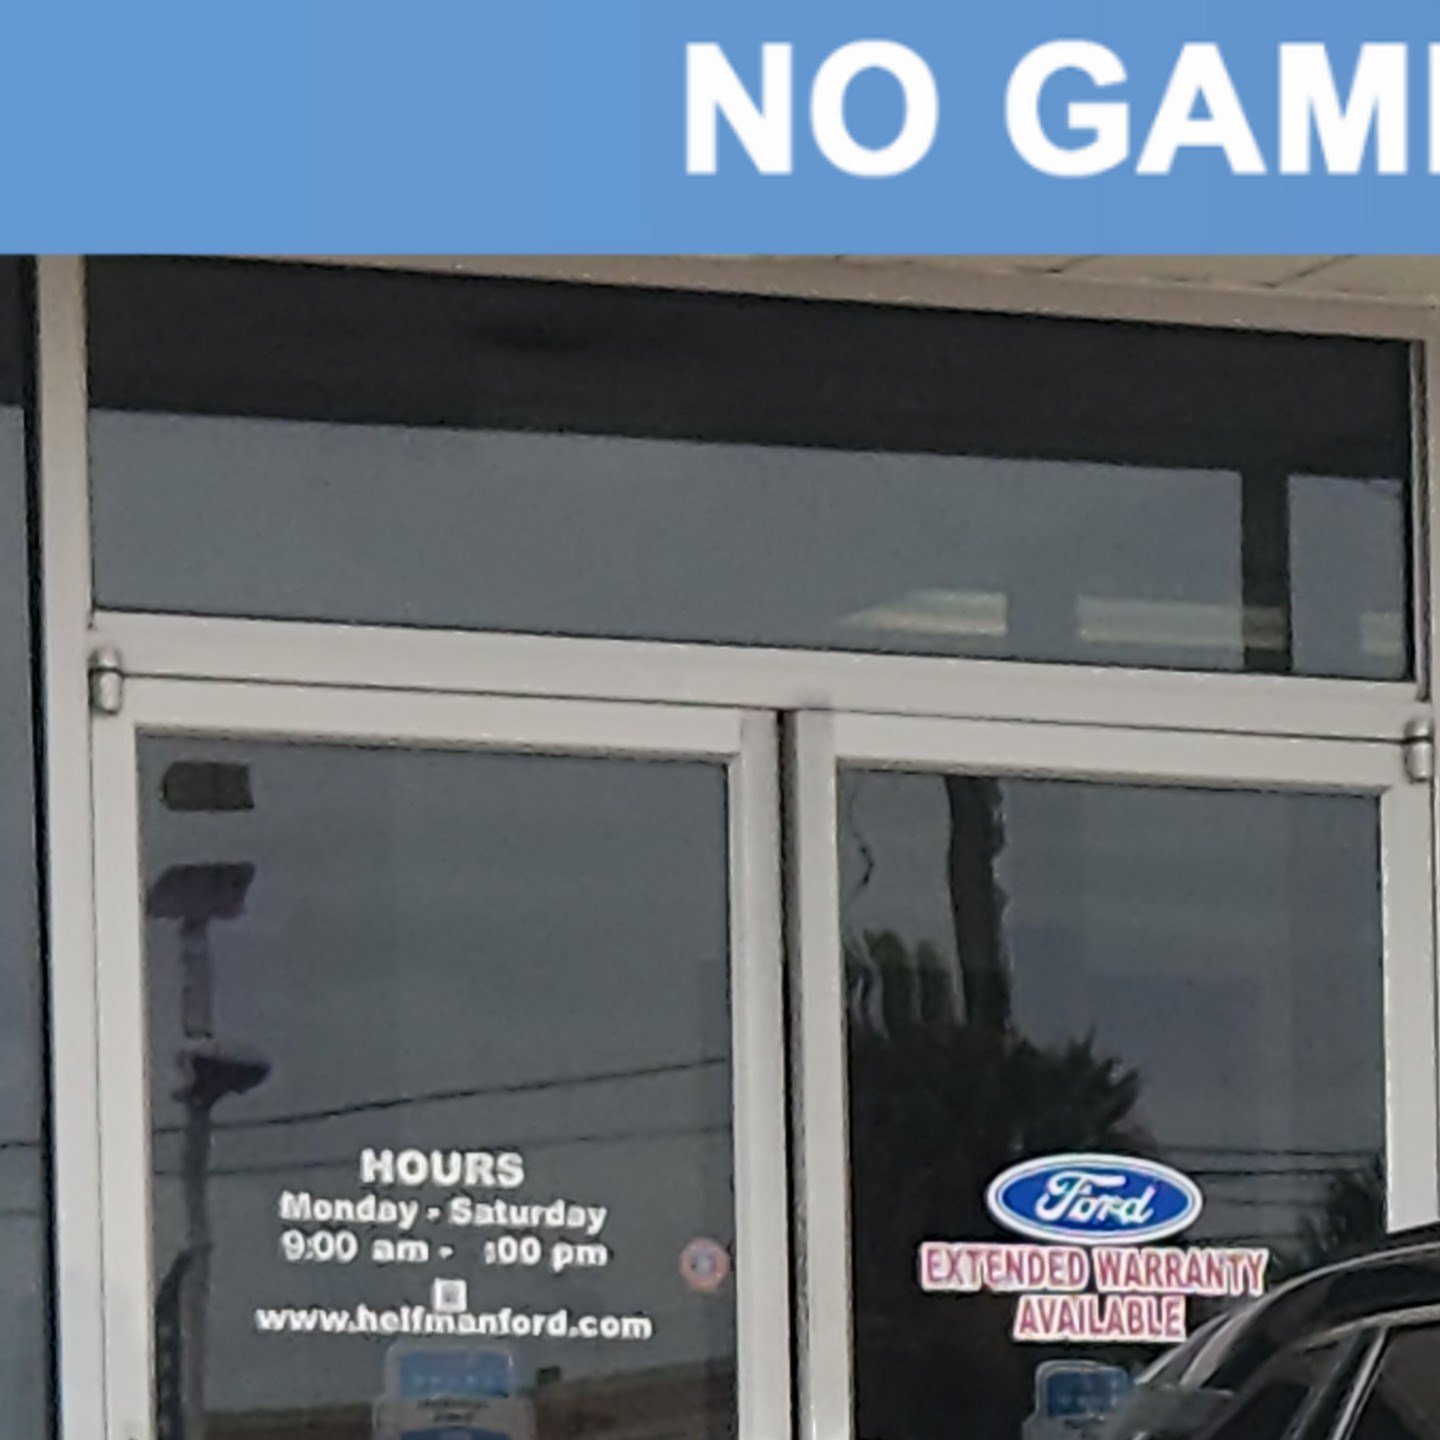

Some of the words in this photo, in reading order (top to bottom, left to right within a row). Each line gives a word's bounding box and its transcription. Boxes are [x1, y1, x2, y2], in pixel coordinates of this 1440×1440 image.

[359, 1148, 526, 1188] HOURS
[279, 1190, 420, 1230] Monday
[447, 1197, 608, 1235] Saturday
[1033, 1170, 1154, 1224] Ford
[280, 1230, 359, 1263] 9:00
[370, 1238, 430, 1264] am
[550, 1243, 609, 1272] pm
[924, 1247, 1087, 1287] EXTENDED
[1095, 1250, 1265, 1292] WARRANTY
[255, 1303, 654, 1340] www.helfmanford.com
[1017, 1298, 1183, 1338] AVAILABLE
